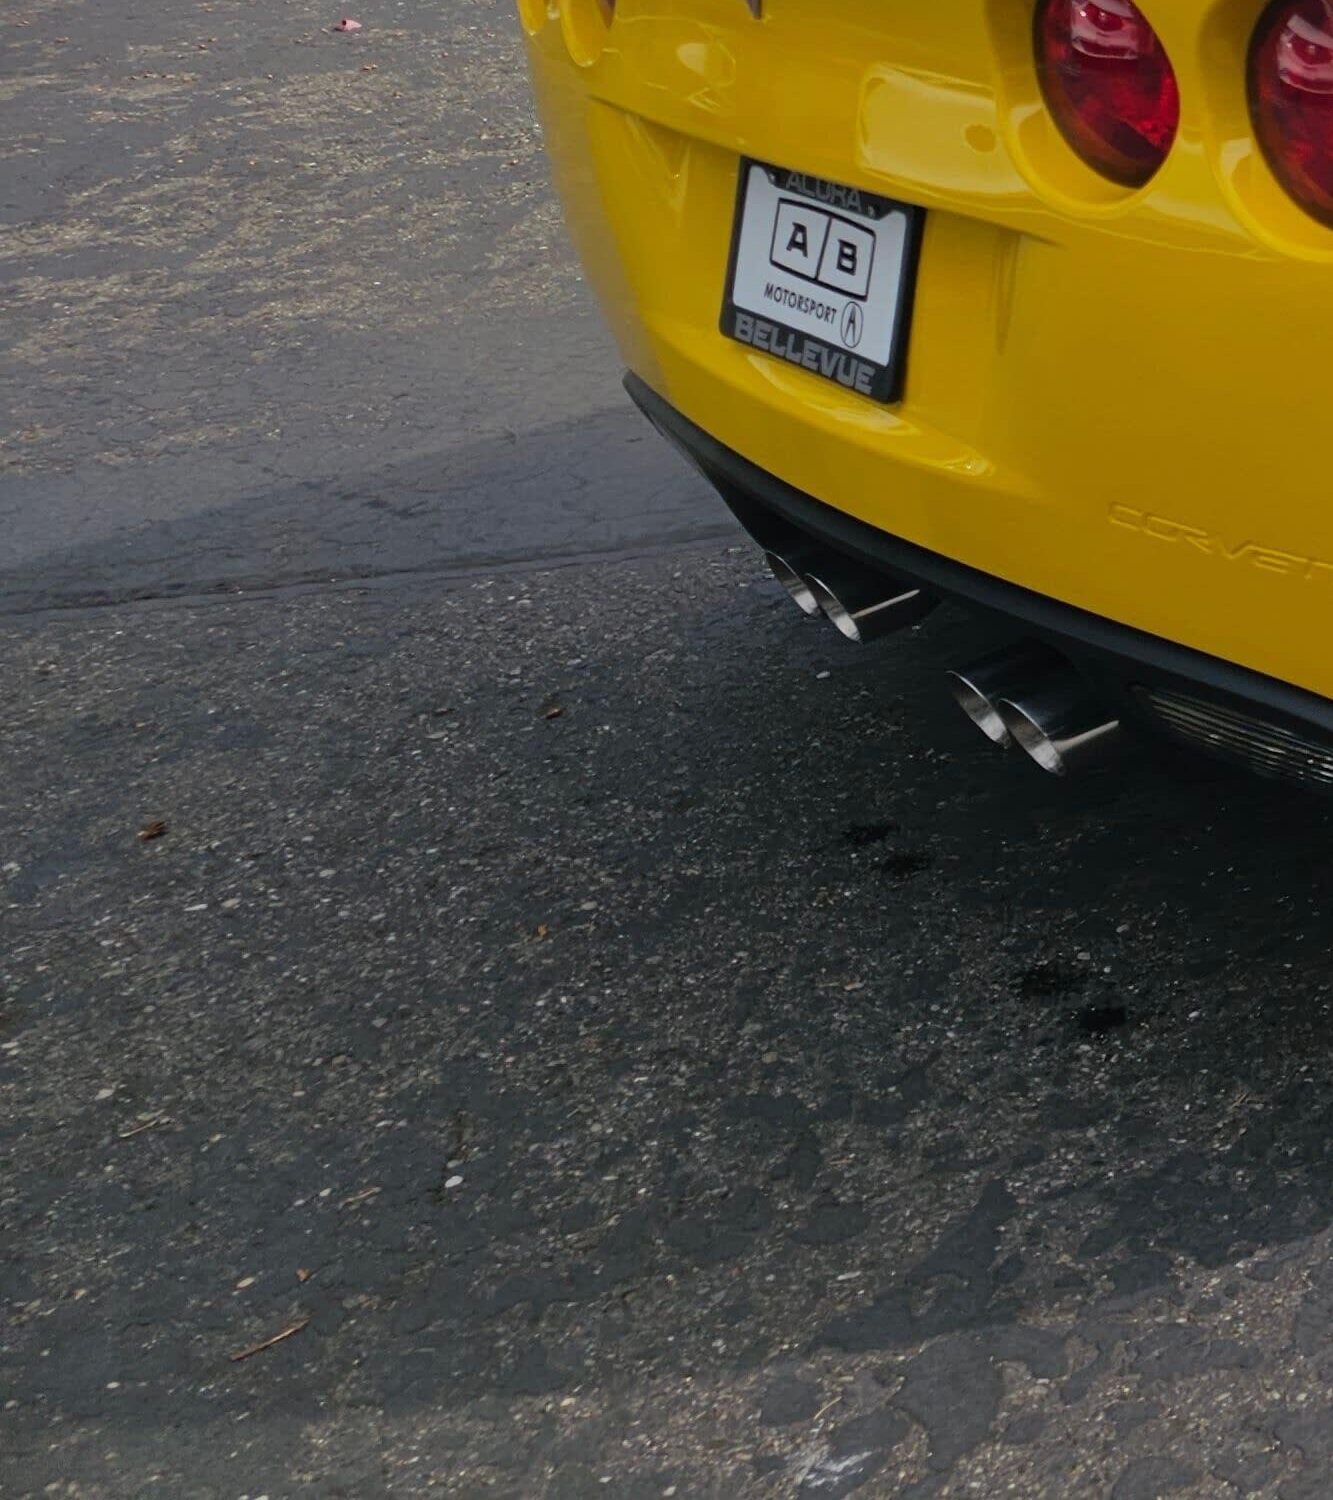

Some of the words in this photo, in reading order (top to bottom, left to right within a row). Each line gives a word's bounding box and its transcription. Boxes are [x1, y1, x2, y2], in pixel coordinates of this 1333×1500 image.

[785, 221, 809, 258] A
[836, 238, 858, 276] B
[763, 283, 837, 325] MOTORSPORT
[733, 311, 876, 395] BELLEVUE
